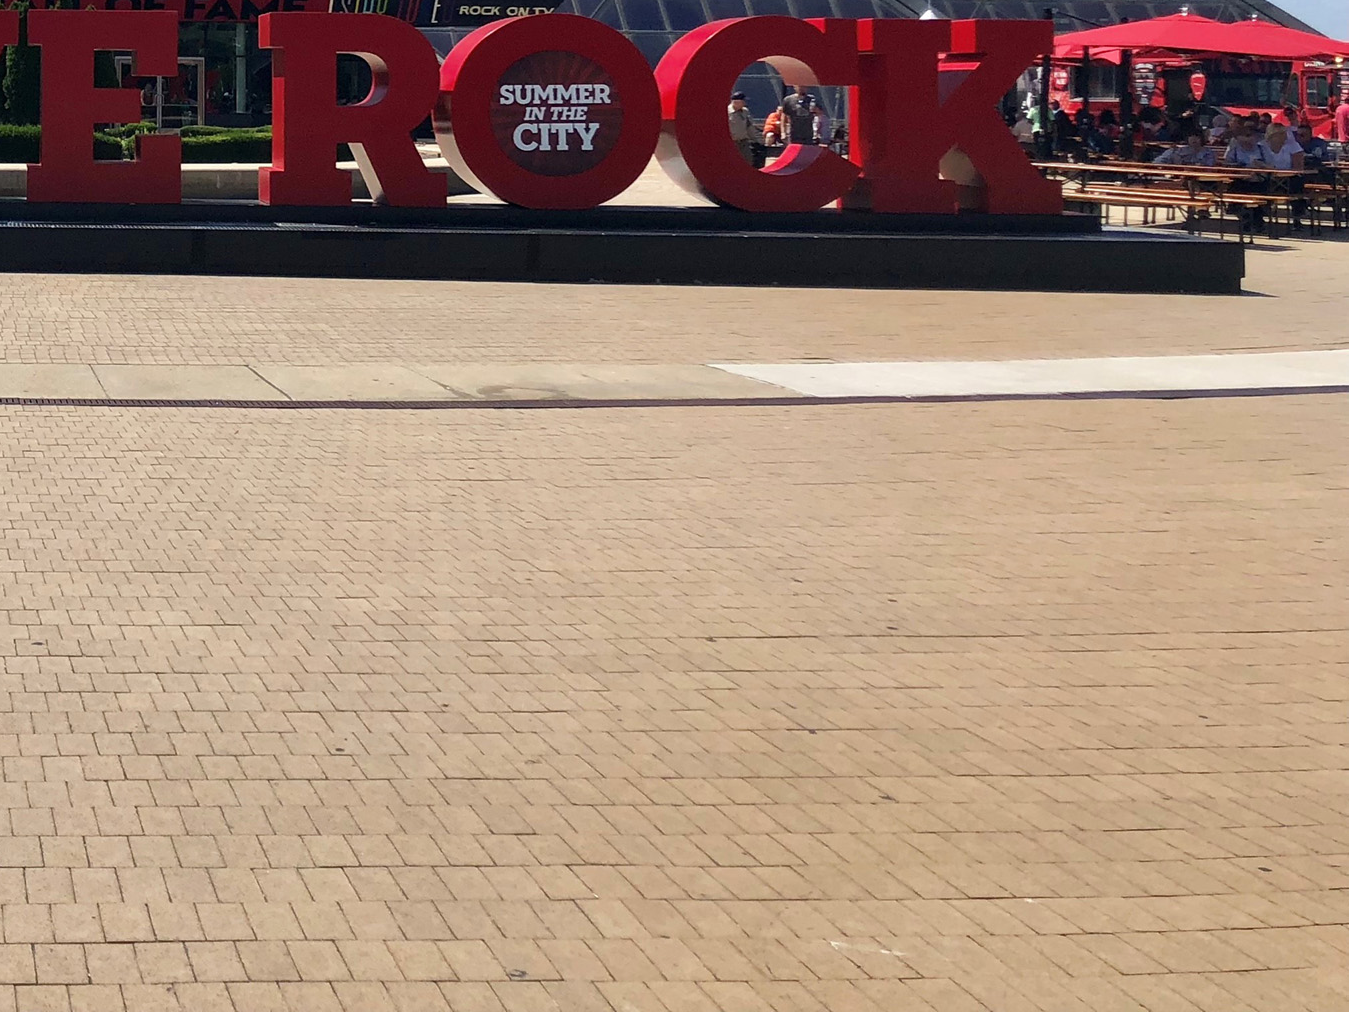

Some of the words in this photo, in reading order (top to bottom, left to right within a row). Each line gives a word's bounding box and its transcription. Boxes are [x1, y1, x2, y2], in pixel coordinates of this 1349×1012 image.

[458, 5, 501, 16] ROCK
[506, 6, 530, 17] ON
[500, 84, 611, 105] SUMMER
[258, 11, 1063, 215] ROCK
[524, 107, 546, 120] IN
[550, 107, 588, 120] THE
[513, 123, 600, 151] CITY
